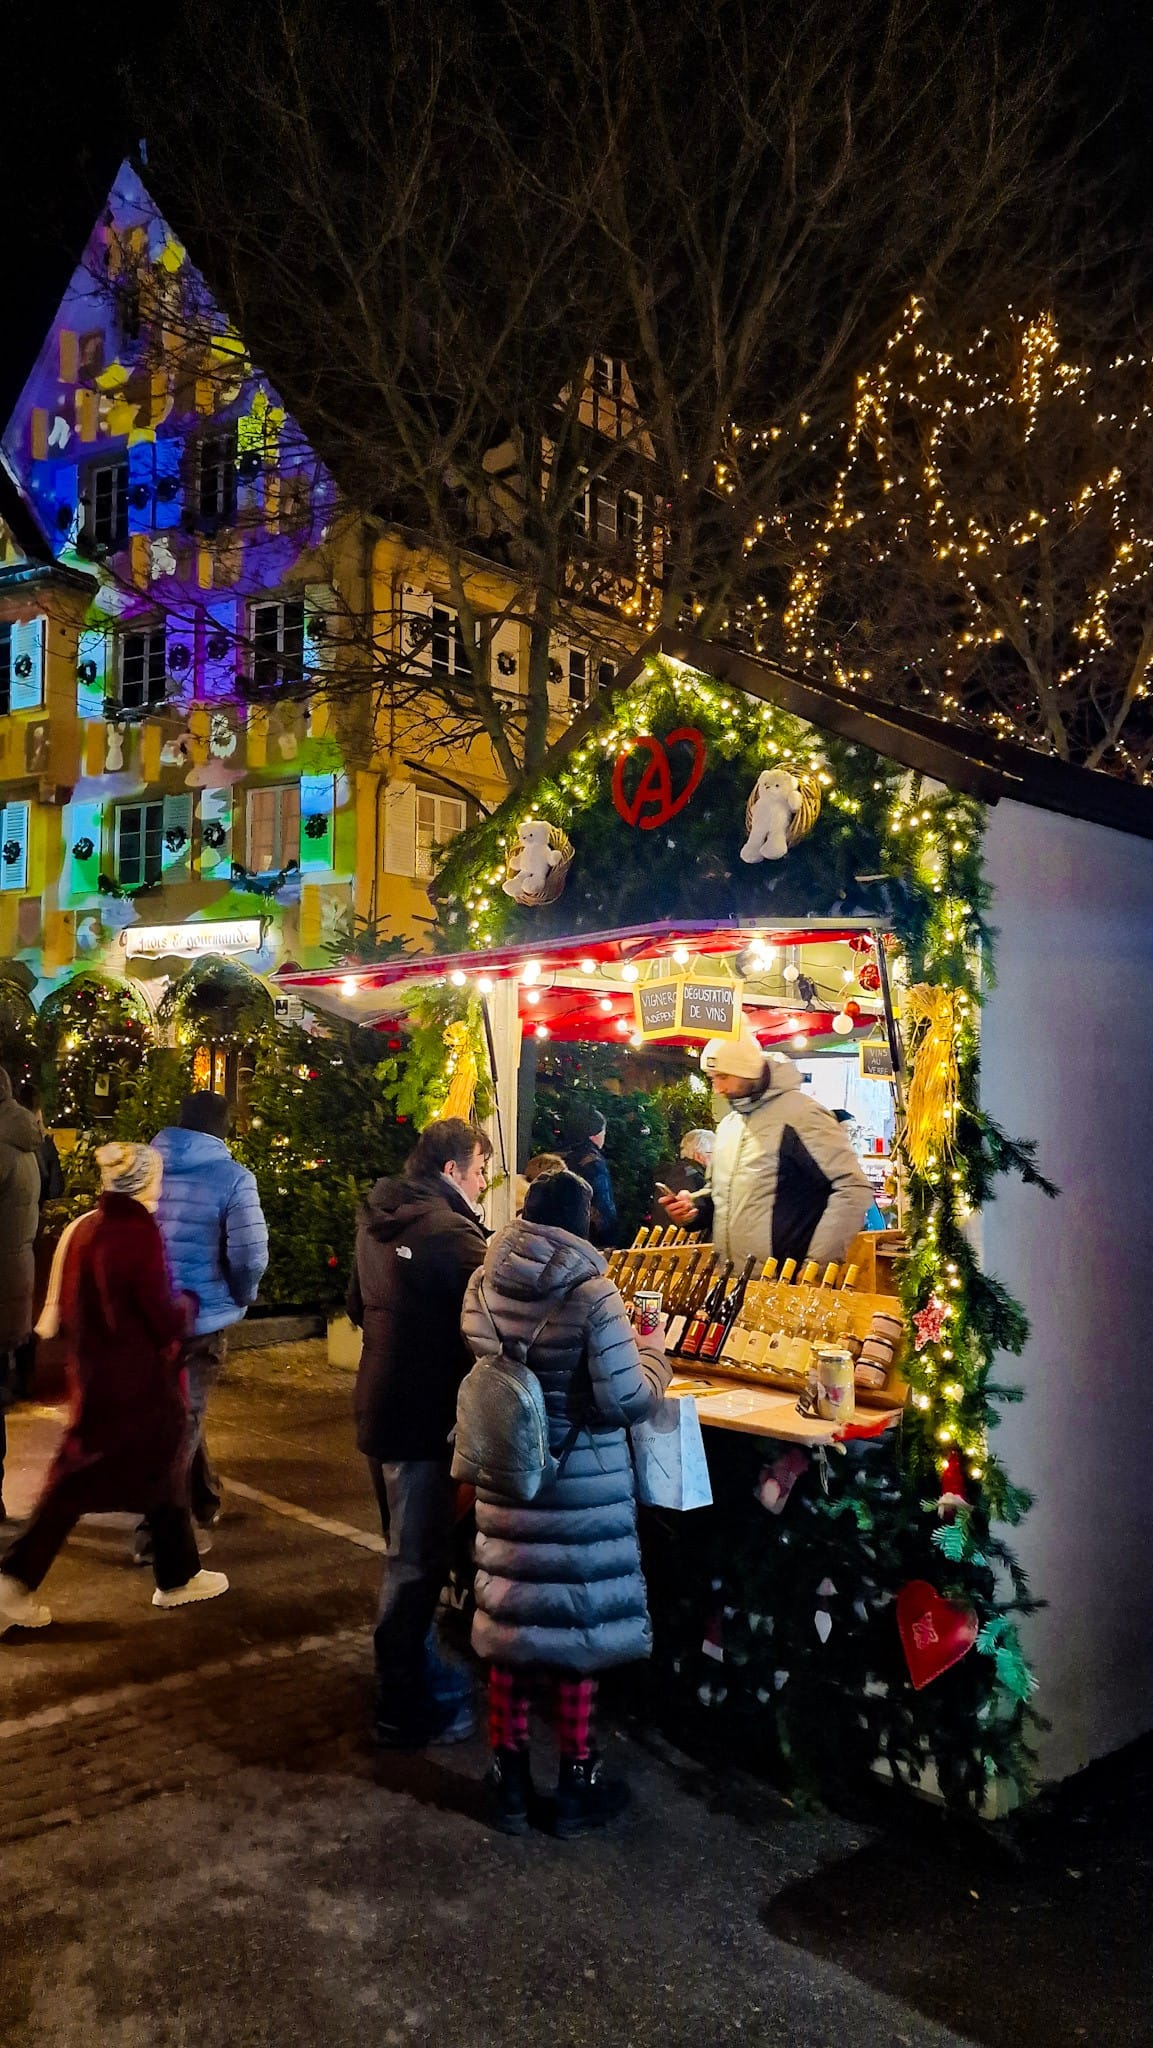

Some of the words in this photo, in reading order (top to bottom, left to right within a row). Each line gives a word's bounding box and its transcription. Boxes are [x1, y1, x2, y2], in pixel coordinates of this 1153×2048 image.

[186, 927, 250, 949] gourmande
[684, 985, 735, 1005] DÉGUSTATION
[690, 1005, 702, 1018] DE
[705, 1006, 727, 1022] VINS
[870, 1048, 888, 1057] VINS
